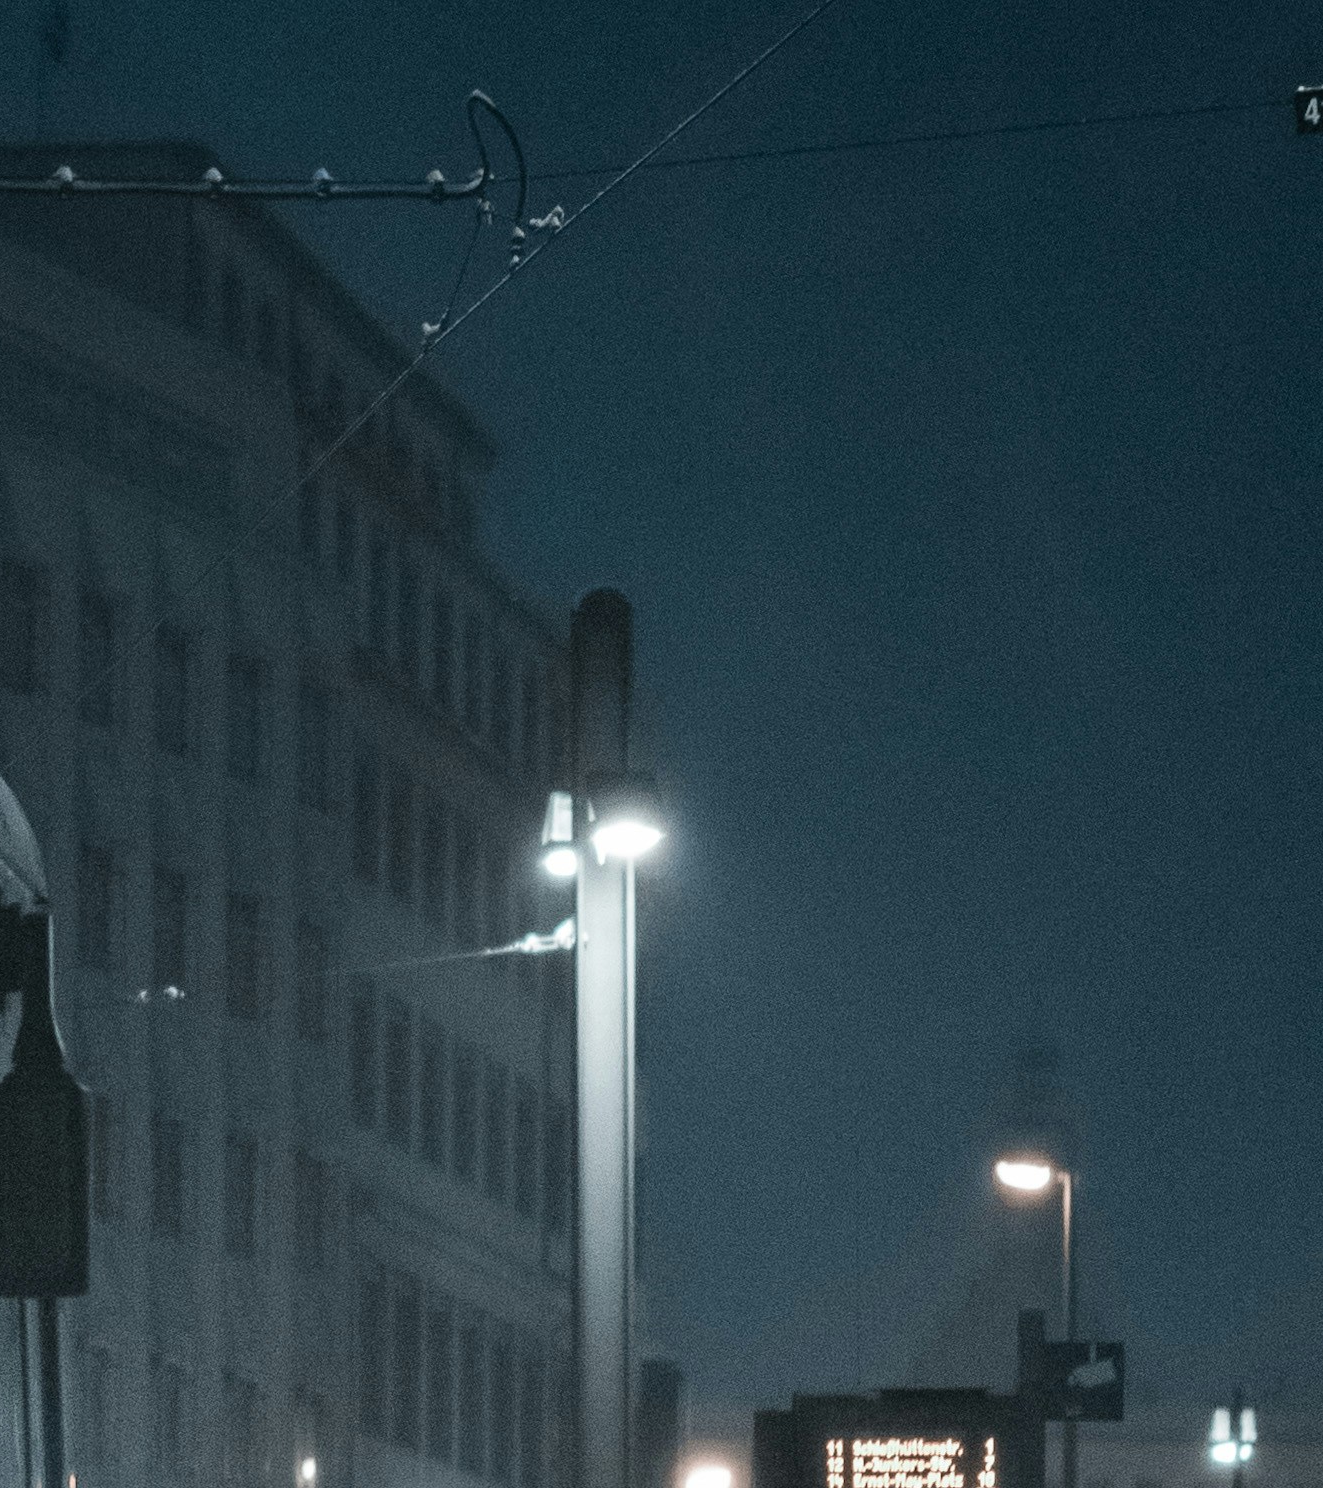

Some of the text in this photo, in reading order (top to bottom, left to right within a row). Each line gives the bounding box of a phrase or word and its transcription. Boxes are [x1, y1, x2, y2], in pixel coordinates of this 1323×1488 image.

[827, 1440, 843, 1457] 11
[985, 1438, 994, 1456] 1
[827, 1457, 844, 1473] 12
[984, 1455, 995, 1472] 7
[827, 1472, 844, 1488] 14
